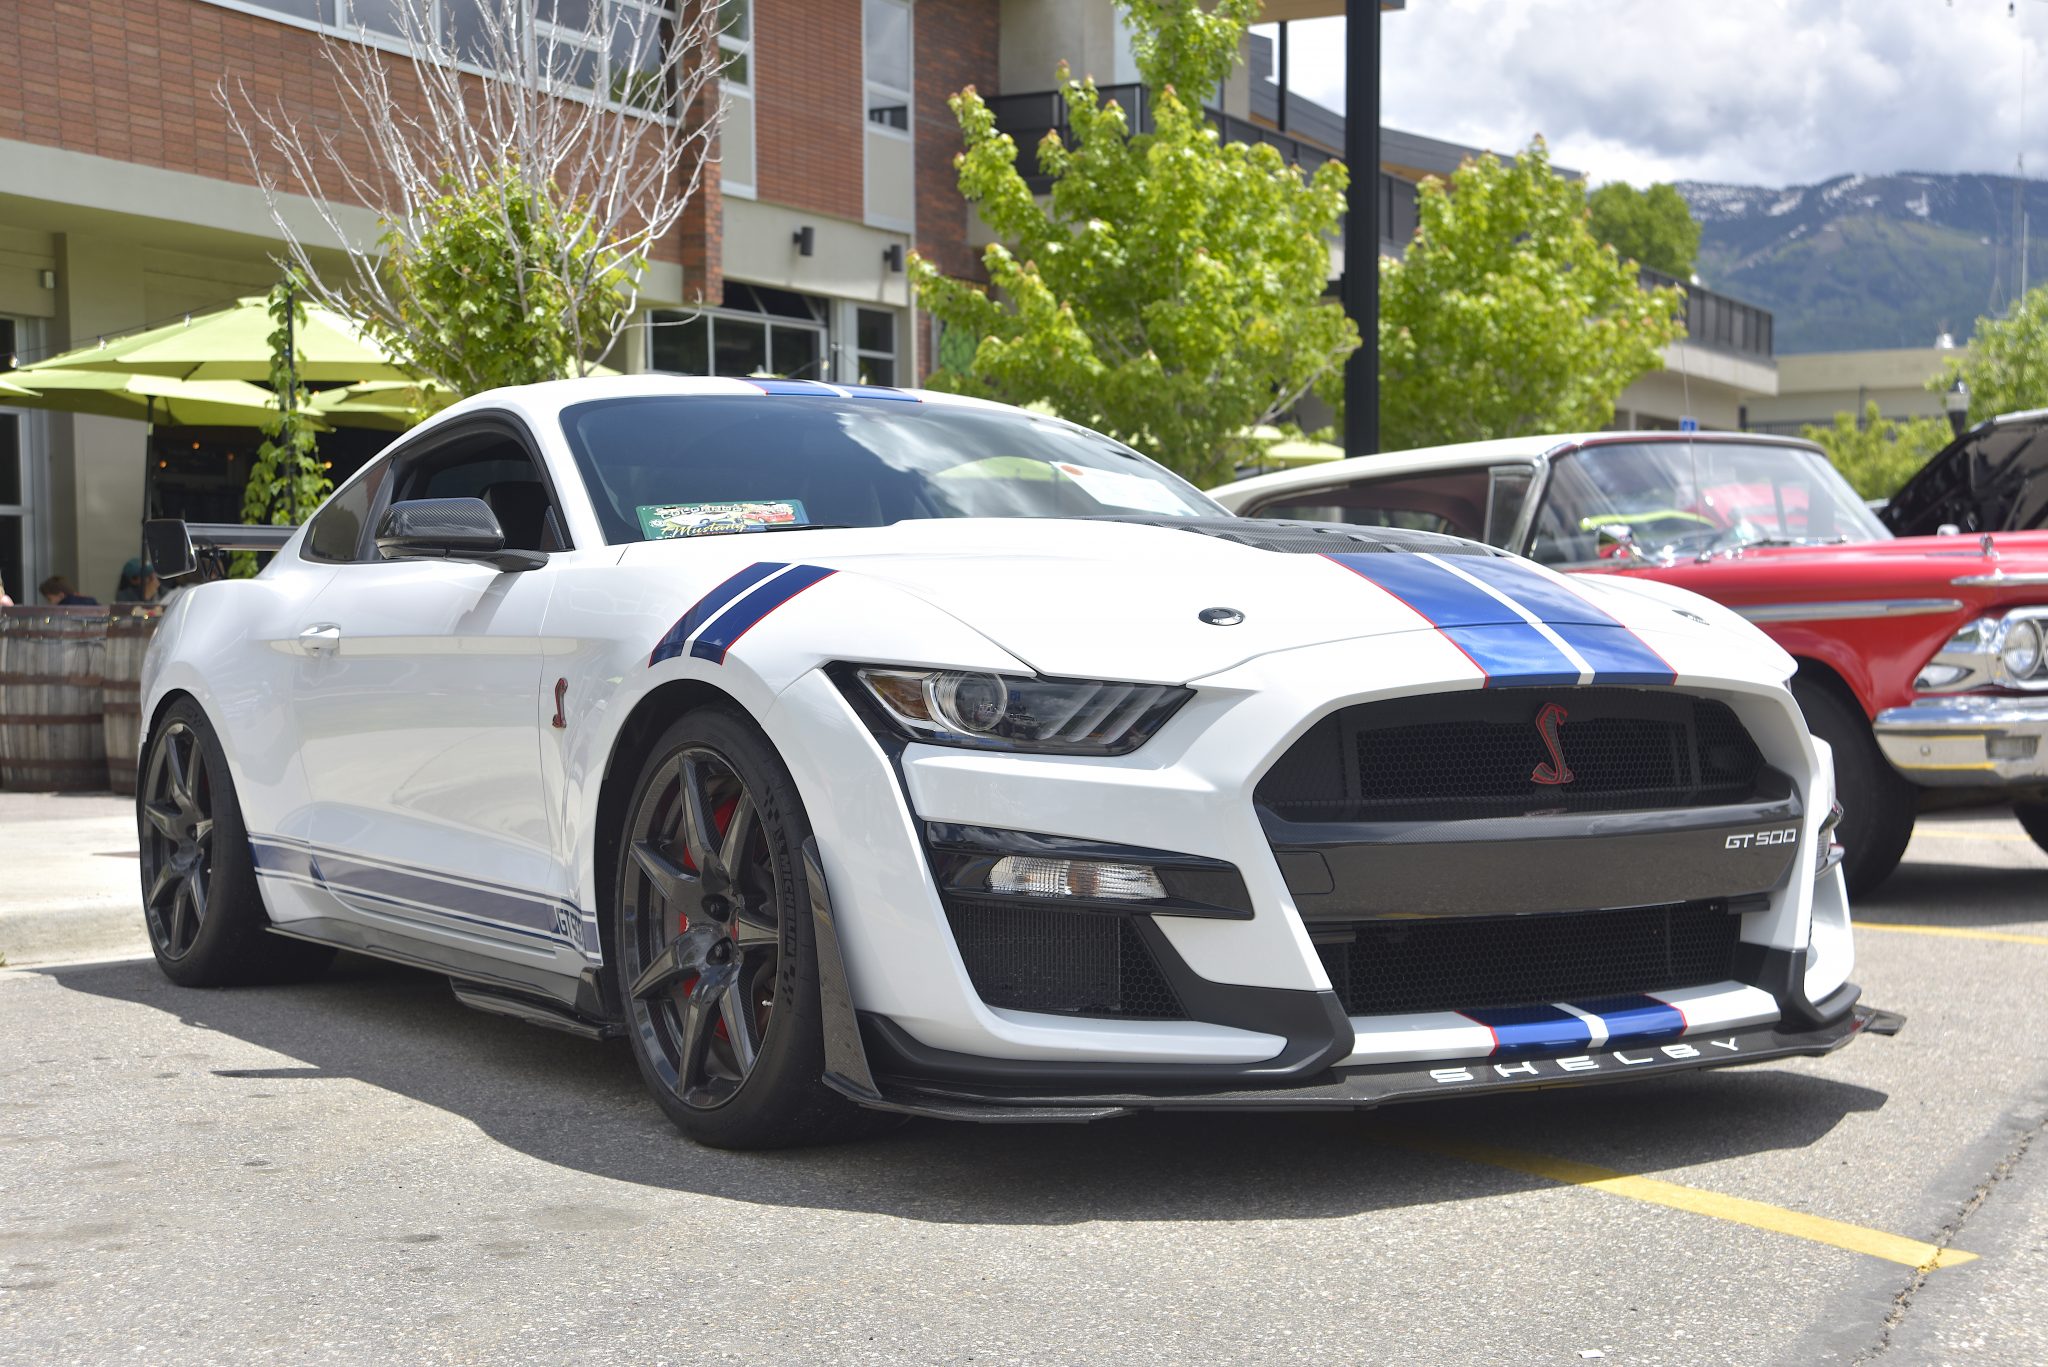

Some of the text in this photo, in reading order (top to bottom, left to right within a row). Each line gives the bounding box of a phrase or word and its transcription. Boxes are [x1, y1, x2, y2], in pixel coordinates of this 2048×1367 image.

[661, 505, 743, 519] COLORADO
[661, 522, 747, 538] Mustang
[780, 854, 797, 955] MICHELIN
[1429, 1036, 1740, 1083] SHELBY
